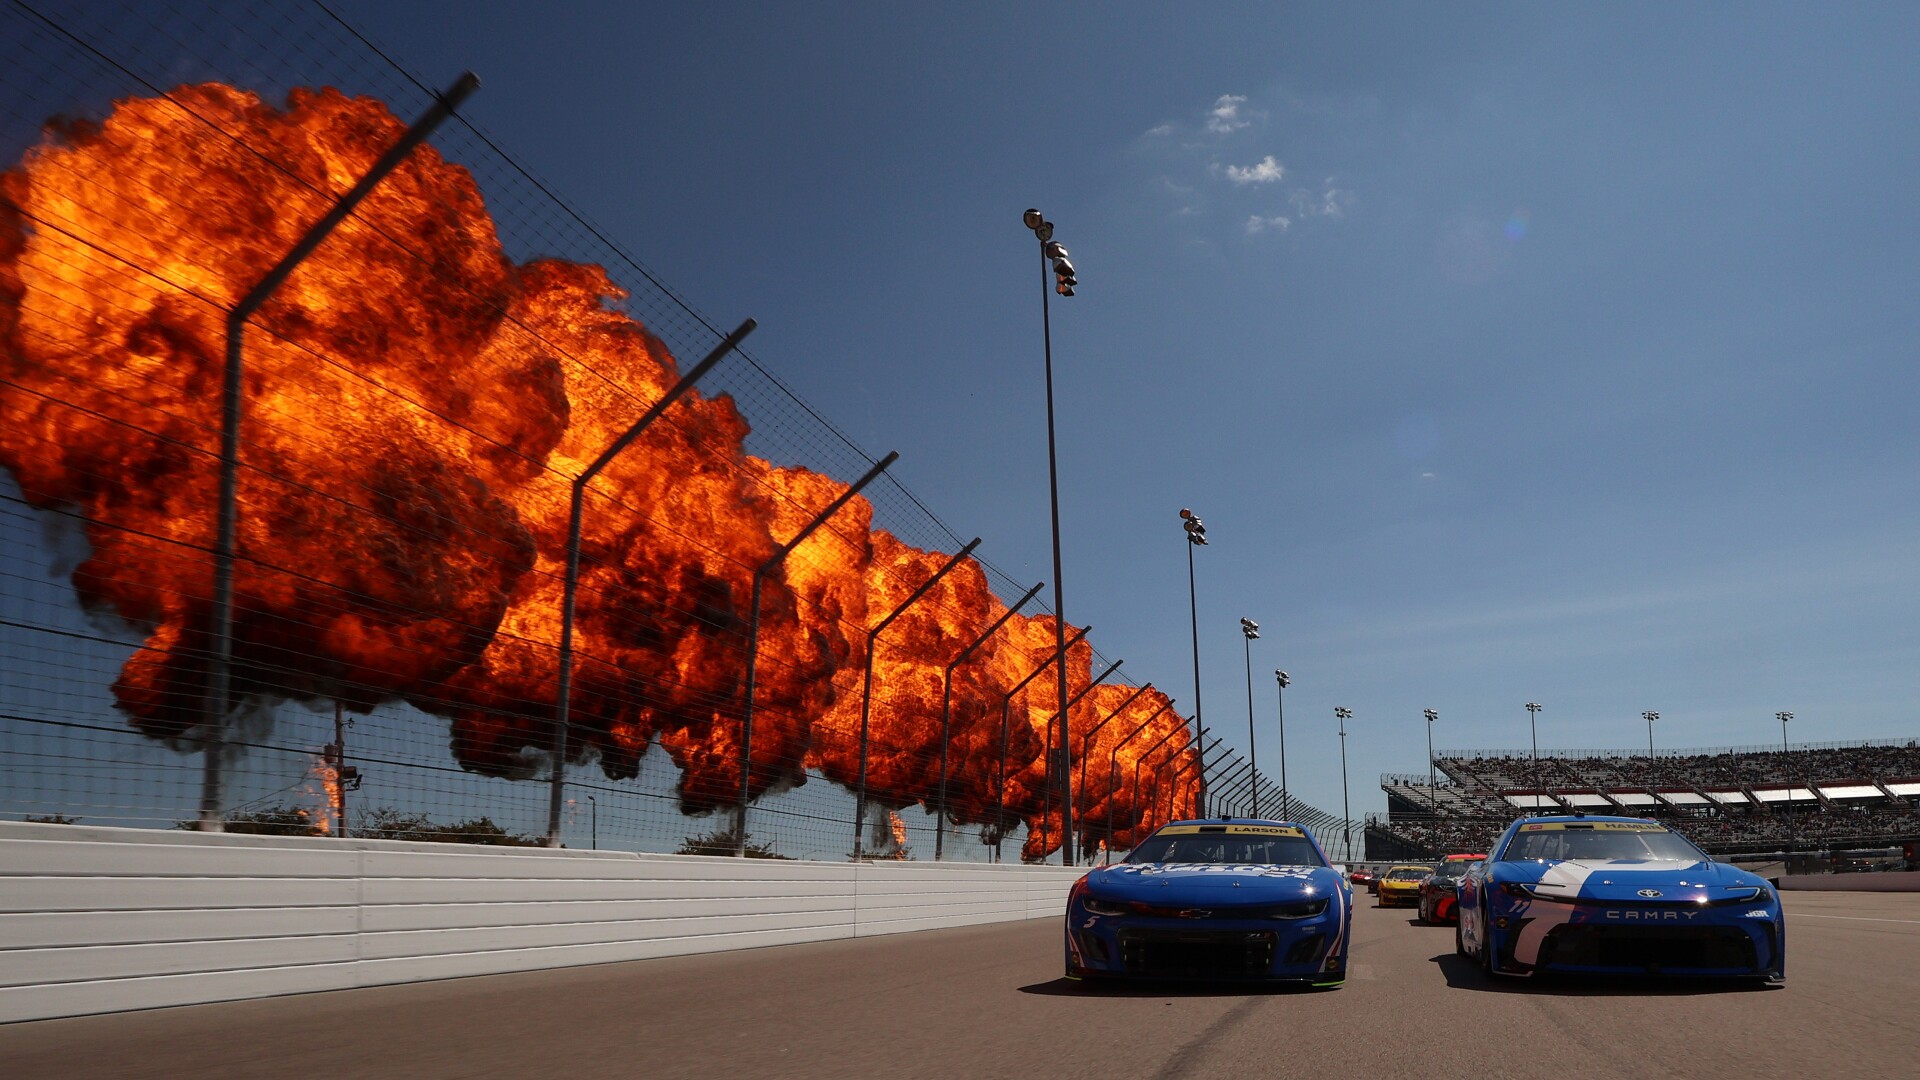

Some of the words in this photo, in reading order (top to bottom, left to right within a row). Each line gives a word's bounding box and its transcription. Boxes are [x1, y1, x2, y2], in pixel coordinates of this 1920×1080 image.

[1606, 911, 1698, 919] CAMRY
[1745, 910, 1770, 918] JGR
[1083, 915, 1100, 928] 5
